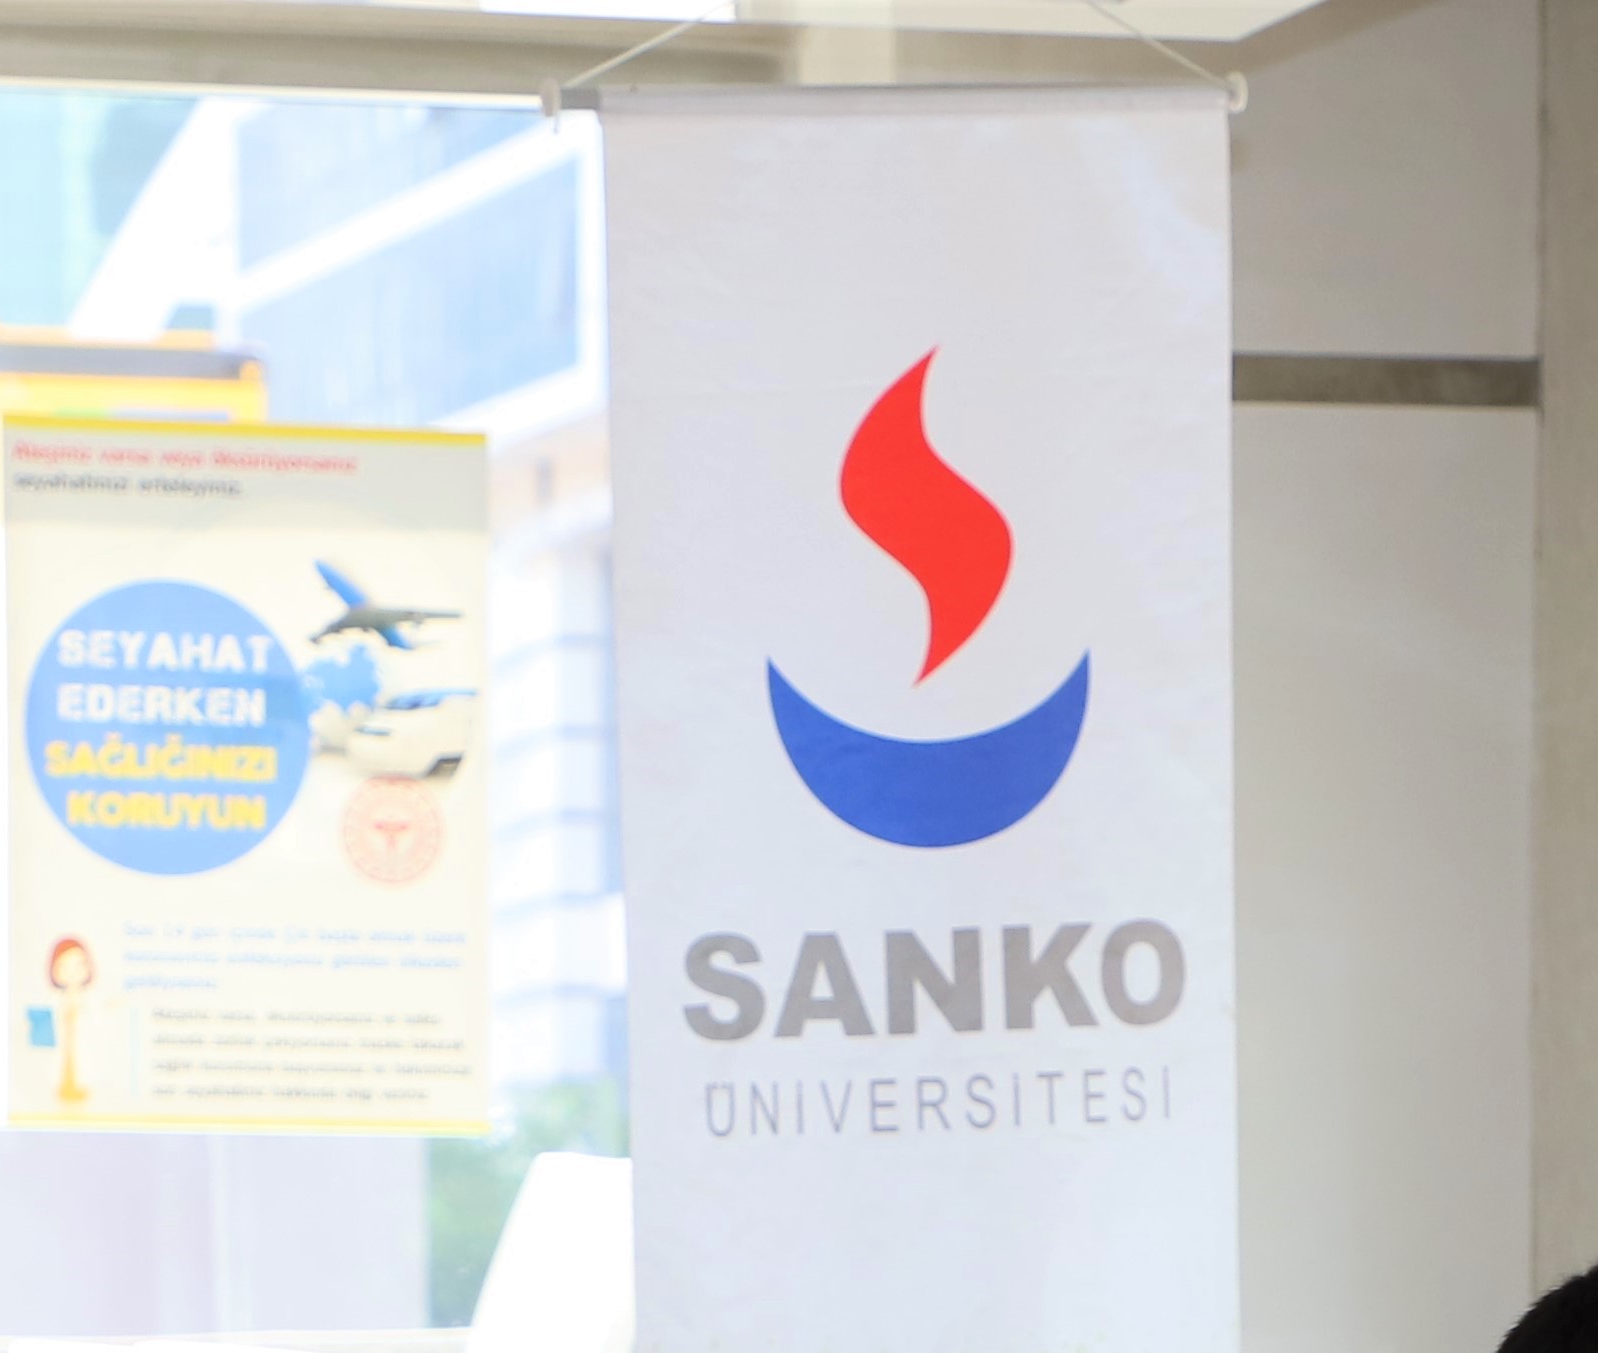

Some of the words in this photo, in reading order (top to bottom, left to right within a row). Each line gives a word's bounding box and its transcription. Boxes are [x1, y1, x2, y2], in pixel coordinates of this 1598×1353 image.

[57, 630, 274, 673] SEYAHAT
[57, 682, 266, 725] EDERKEN
[67, 790, 266, 830] KORUYUN
[683, 918, 1186, 1041] SANKO
